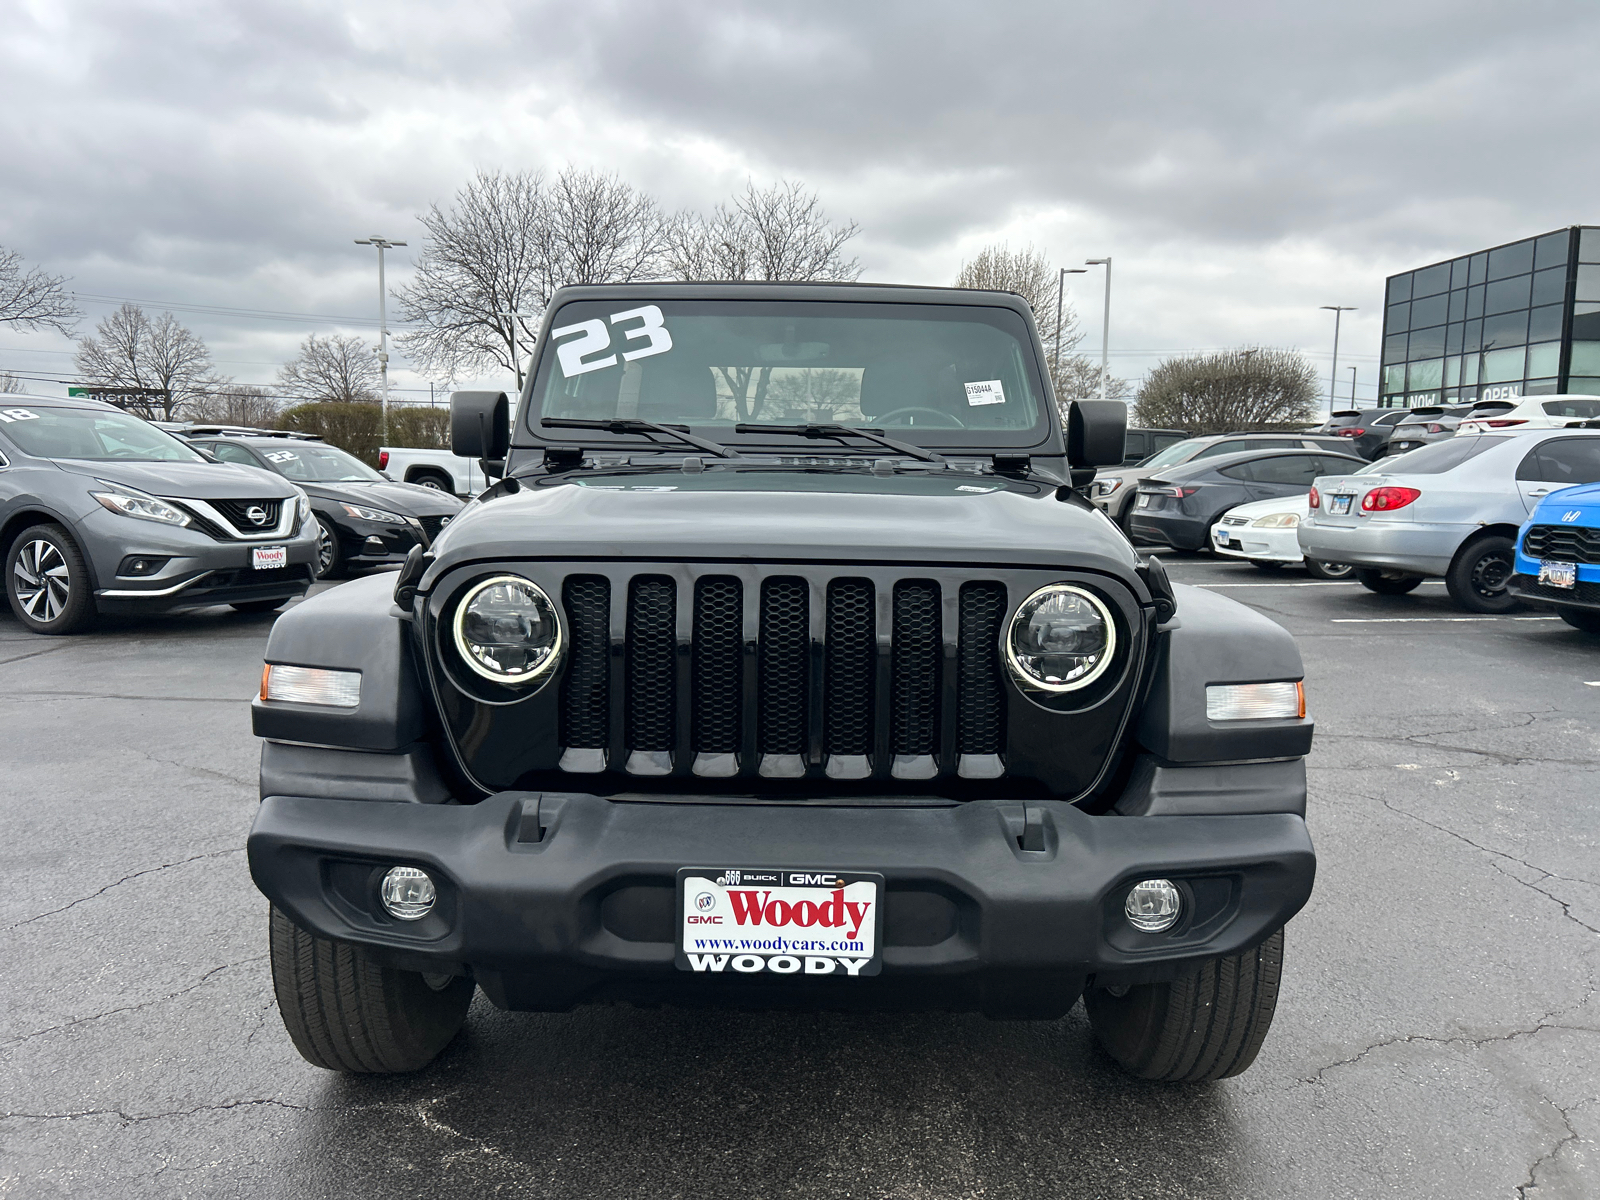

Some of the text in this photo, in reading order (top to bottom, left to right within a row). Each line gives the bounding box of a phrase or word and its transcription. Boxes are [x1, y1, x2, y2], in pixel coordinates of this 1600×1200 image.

[552, 305, 673, 378] 23
[966, 384, 992, 394] G15044A
[1409, 386, 1518, 407] NOW OPEN
[264, 451, 299, 463] 22
[256, 551, 284, 561] Woody
[789, 873, 837, 885] GMC
[687, 916, 723, 924] GMC
[726, 889, 871, 940] Woody
[694, 937, 864, 953] www.woodycars.com
[686, 954, 871, 976] WOODY
